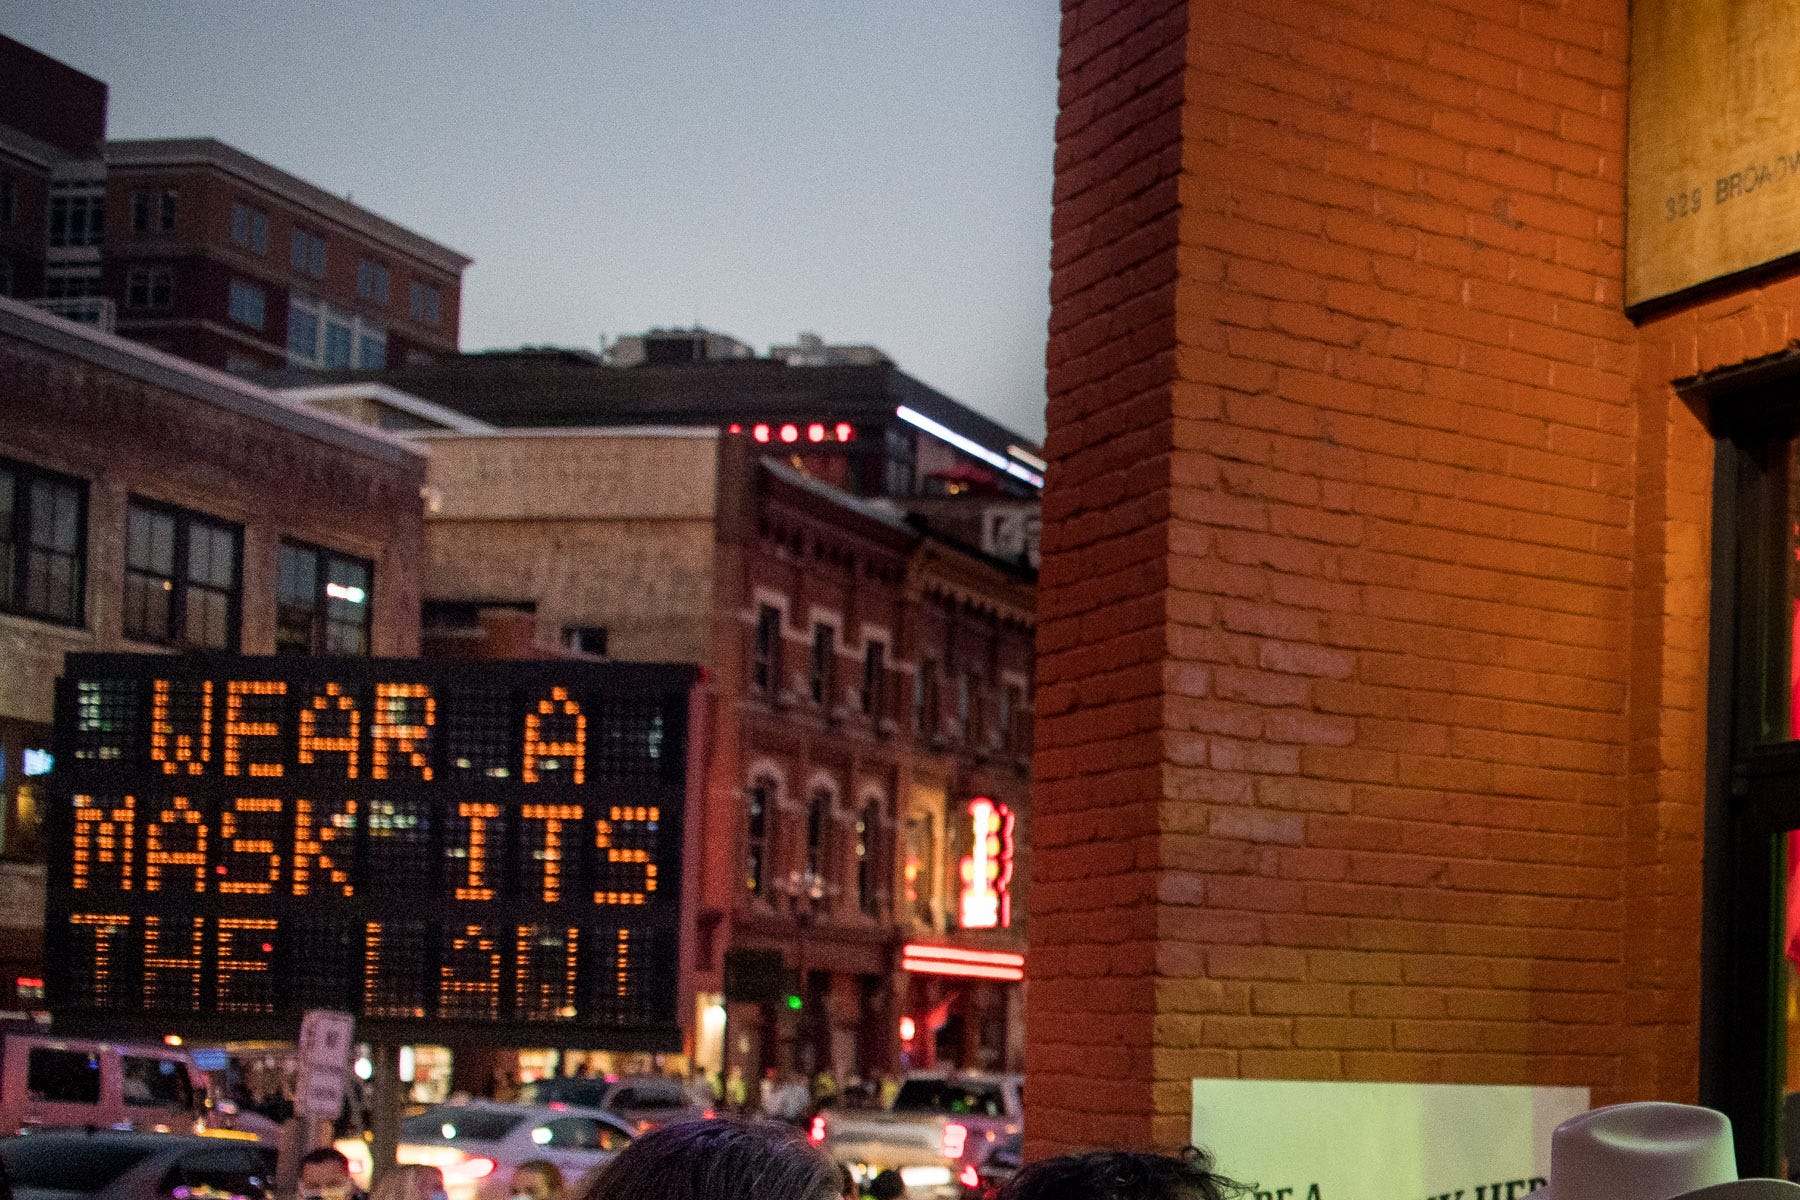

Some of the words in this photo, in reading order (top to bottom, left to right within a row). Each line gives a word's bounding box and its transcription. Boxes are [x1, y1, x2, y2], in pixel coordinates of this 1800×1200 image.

[151, 679, 437, 782] WEAR
[523, 685, 588, 785] A
[72, 795, 355, 898] MASK
[456, 802, 660, 906] ITS
[69, 913, 279, 1013] THE
[364, 920, 630, 1020] LAW!
